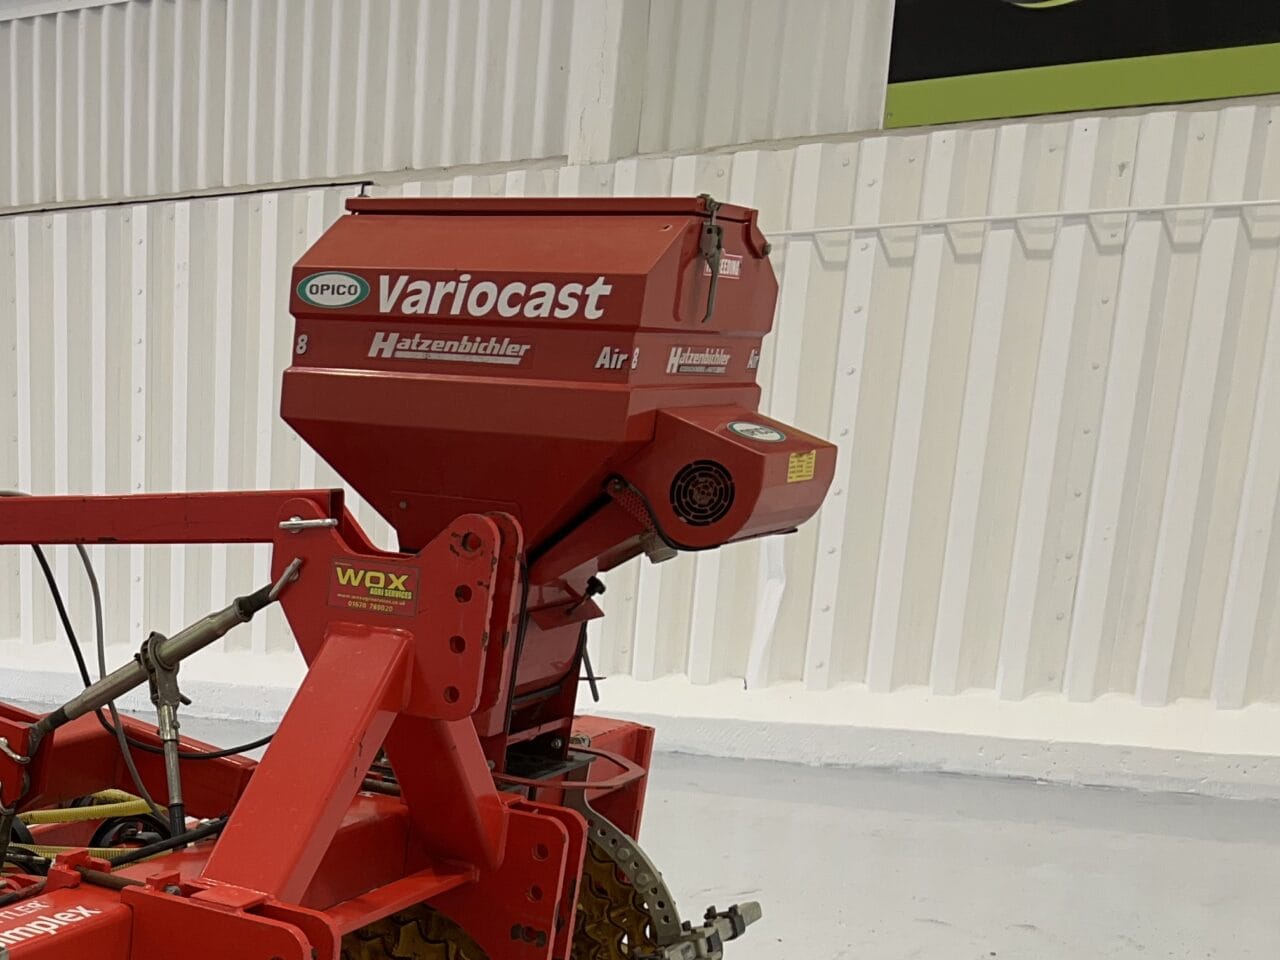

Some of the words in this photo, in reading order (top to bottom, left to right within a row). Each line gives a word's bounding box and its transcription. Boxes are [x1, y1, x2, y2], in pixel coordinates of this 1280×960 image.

[308, 284, 359, 297] OPICO
[379, 274, 613, 320] Variocast
[296, 334, 308, 355] 8
[368, 332, 531, 358] Hatzenbichler
[595, 346, 628, 369] Air
[631, 347, 640, 370] 8
[666, 346, 731, 373] Hatzenbichler
[336, 567, 409, 591] WOX
